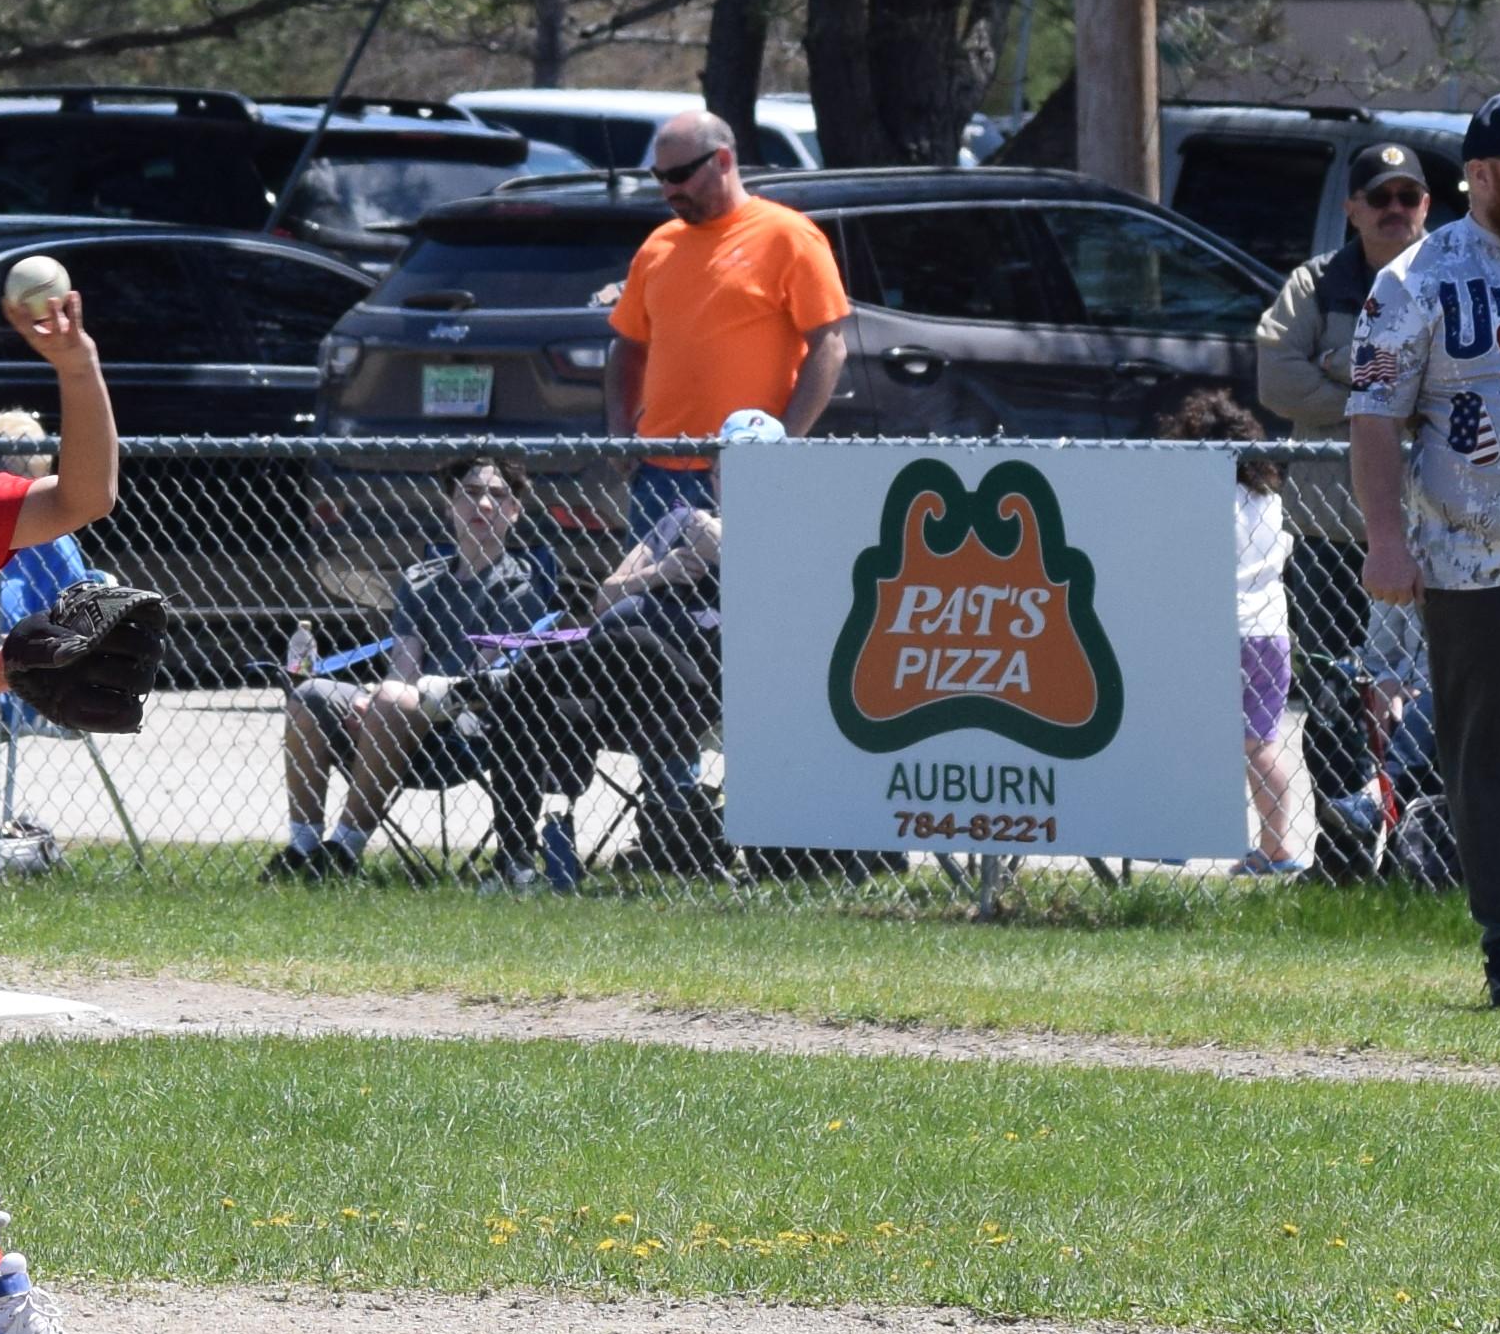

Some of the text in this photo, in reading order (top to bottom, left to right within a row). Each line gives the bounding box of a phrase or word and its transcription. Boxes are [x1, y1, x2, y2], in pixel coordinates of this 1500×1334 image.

[884, 583, 1051, 639] PAT'S
[894, 646, 1032, 693] PIZZA
[886, 761, 1056, 806] AUBURN
[893, 810, 1058, 843] 784-8221
